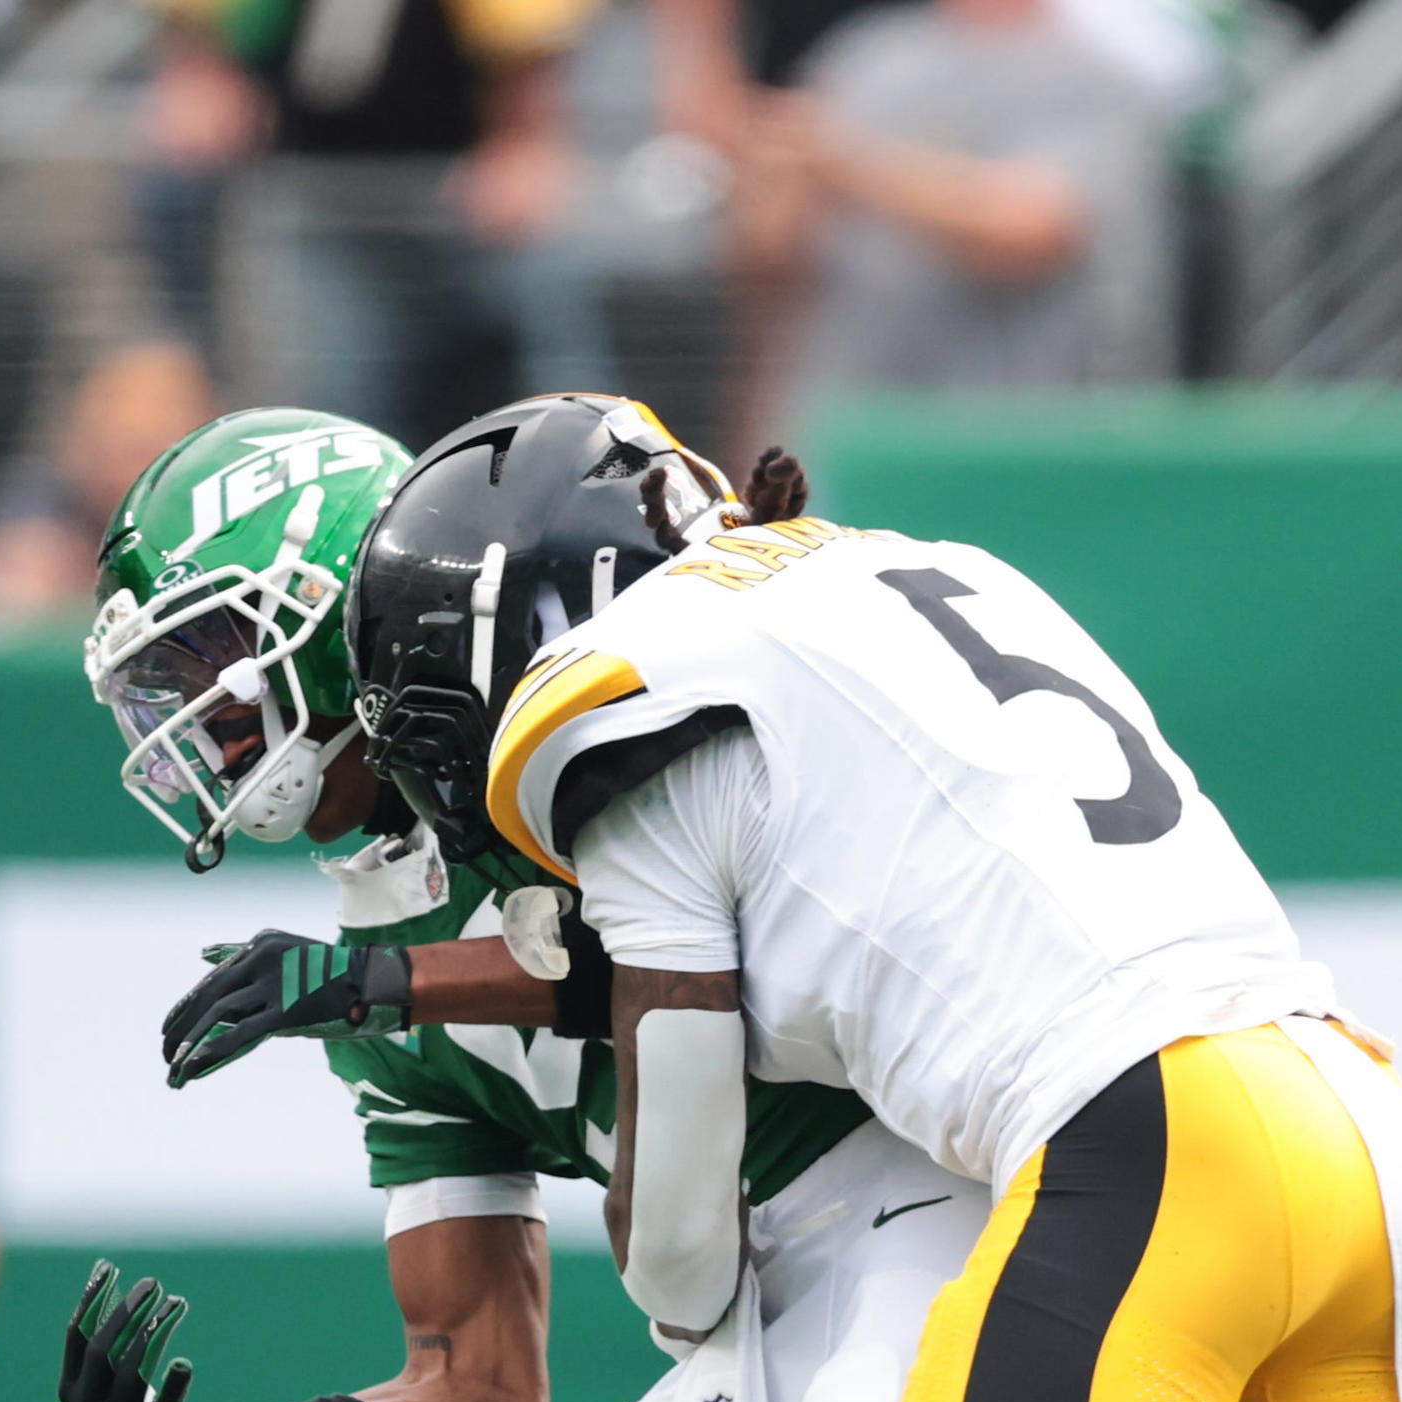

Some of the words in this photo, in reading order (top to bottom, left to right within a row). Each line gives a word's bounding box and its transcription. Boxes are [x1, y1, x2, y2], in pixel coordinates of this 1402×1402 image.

[170, 426, 384, 562] JETS
[664, 516, 882, 592] RAM
[874, 567, 1182, 845] 5
